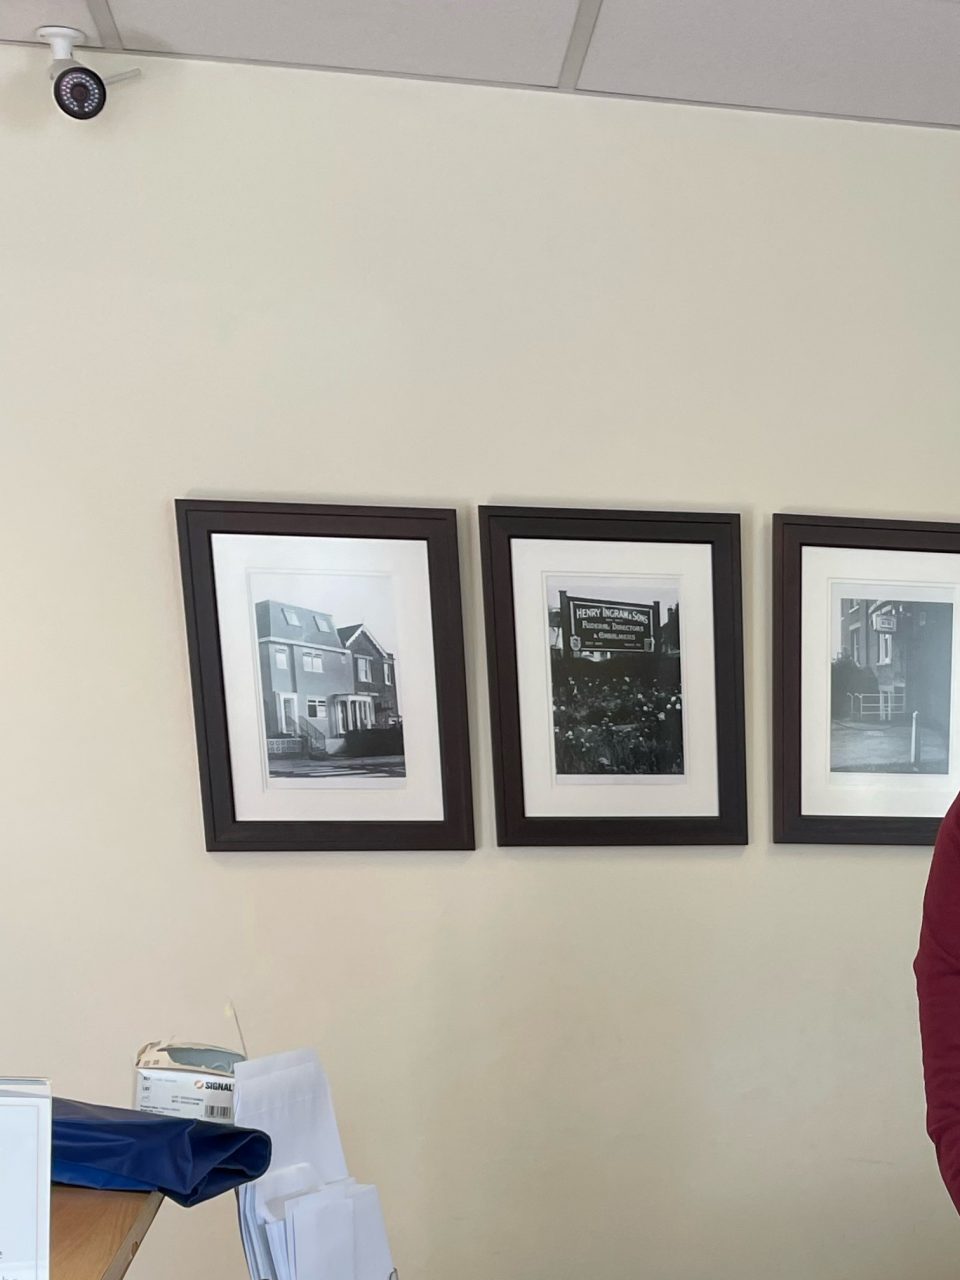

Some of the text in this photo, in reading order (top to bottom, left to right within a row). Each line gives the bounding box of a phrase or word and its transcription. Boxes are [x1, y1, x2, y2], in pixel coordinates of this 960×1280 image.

[576, 608, 601, 619] HENRY
[602, 607, 629, 619] INGRAM
[632, 611, 648, 624] SONS
